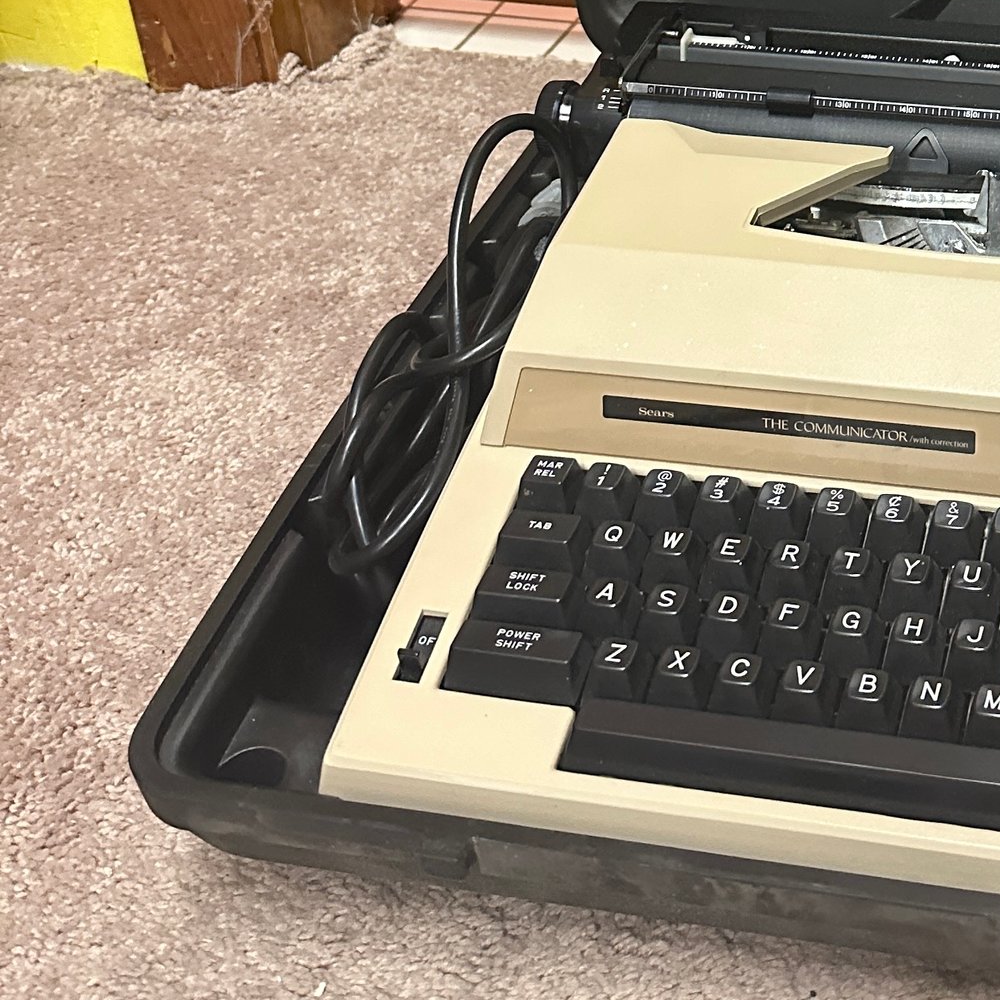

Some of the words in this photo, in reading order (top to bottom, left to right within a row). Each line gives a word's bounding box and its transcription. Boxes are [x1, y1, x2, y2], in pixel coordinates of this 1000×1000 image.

[638, 407, 675, 419] Sears
[762, 417, 789, 431] THE
[794, 420, 908, 443] COMMUNICATOR
[931, 438, 969, 449] correction
[533, 467, 555, 478] REL
[536, 461, 563, 470] MAR
[652, 482, 666, 493] 2
[710, 489, 723, 498] 3
[767, 496, 780, 505] 4
[826, 501, 840, 511] 5
[885, 508, 899, 518] 6
[944, 514, 958, 527] 7
[529, 521, 552, 529] TAB
[605, 526, 622, 541] Q
[664, 532, 683, 548] W
[720, 539, 740, 555] E
[781, 545, 799, 562] R
[845, 552, 860, 569] T
[905, 559, 920, 575] Y
[508, 572, 546, 584] SHIFT
[963, 566, 981, 582] U
[506, 582, 538, 591] LOCK
[596, 583, 613, 600] A
[657, 590, 676, 607] S
[718, 596, 737, 613] D
[779, 604, 800, 620] F
[842, 612, 860, 629] G
[904, 618, 923, 636] H
[497, 629, 540, 642] POWER
[967, 626, 984, 642] J
[495, 637, 535, 650] SHIFT
[605, 644, 627, 662] Z
[668, 651, 690, 670] X
[731, 659, 750, 677] C
[797, 666, 815, 685] V
[859, 674, 876, 693] B
[920, 681, 941, 701] N
